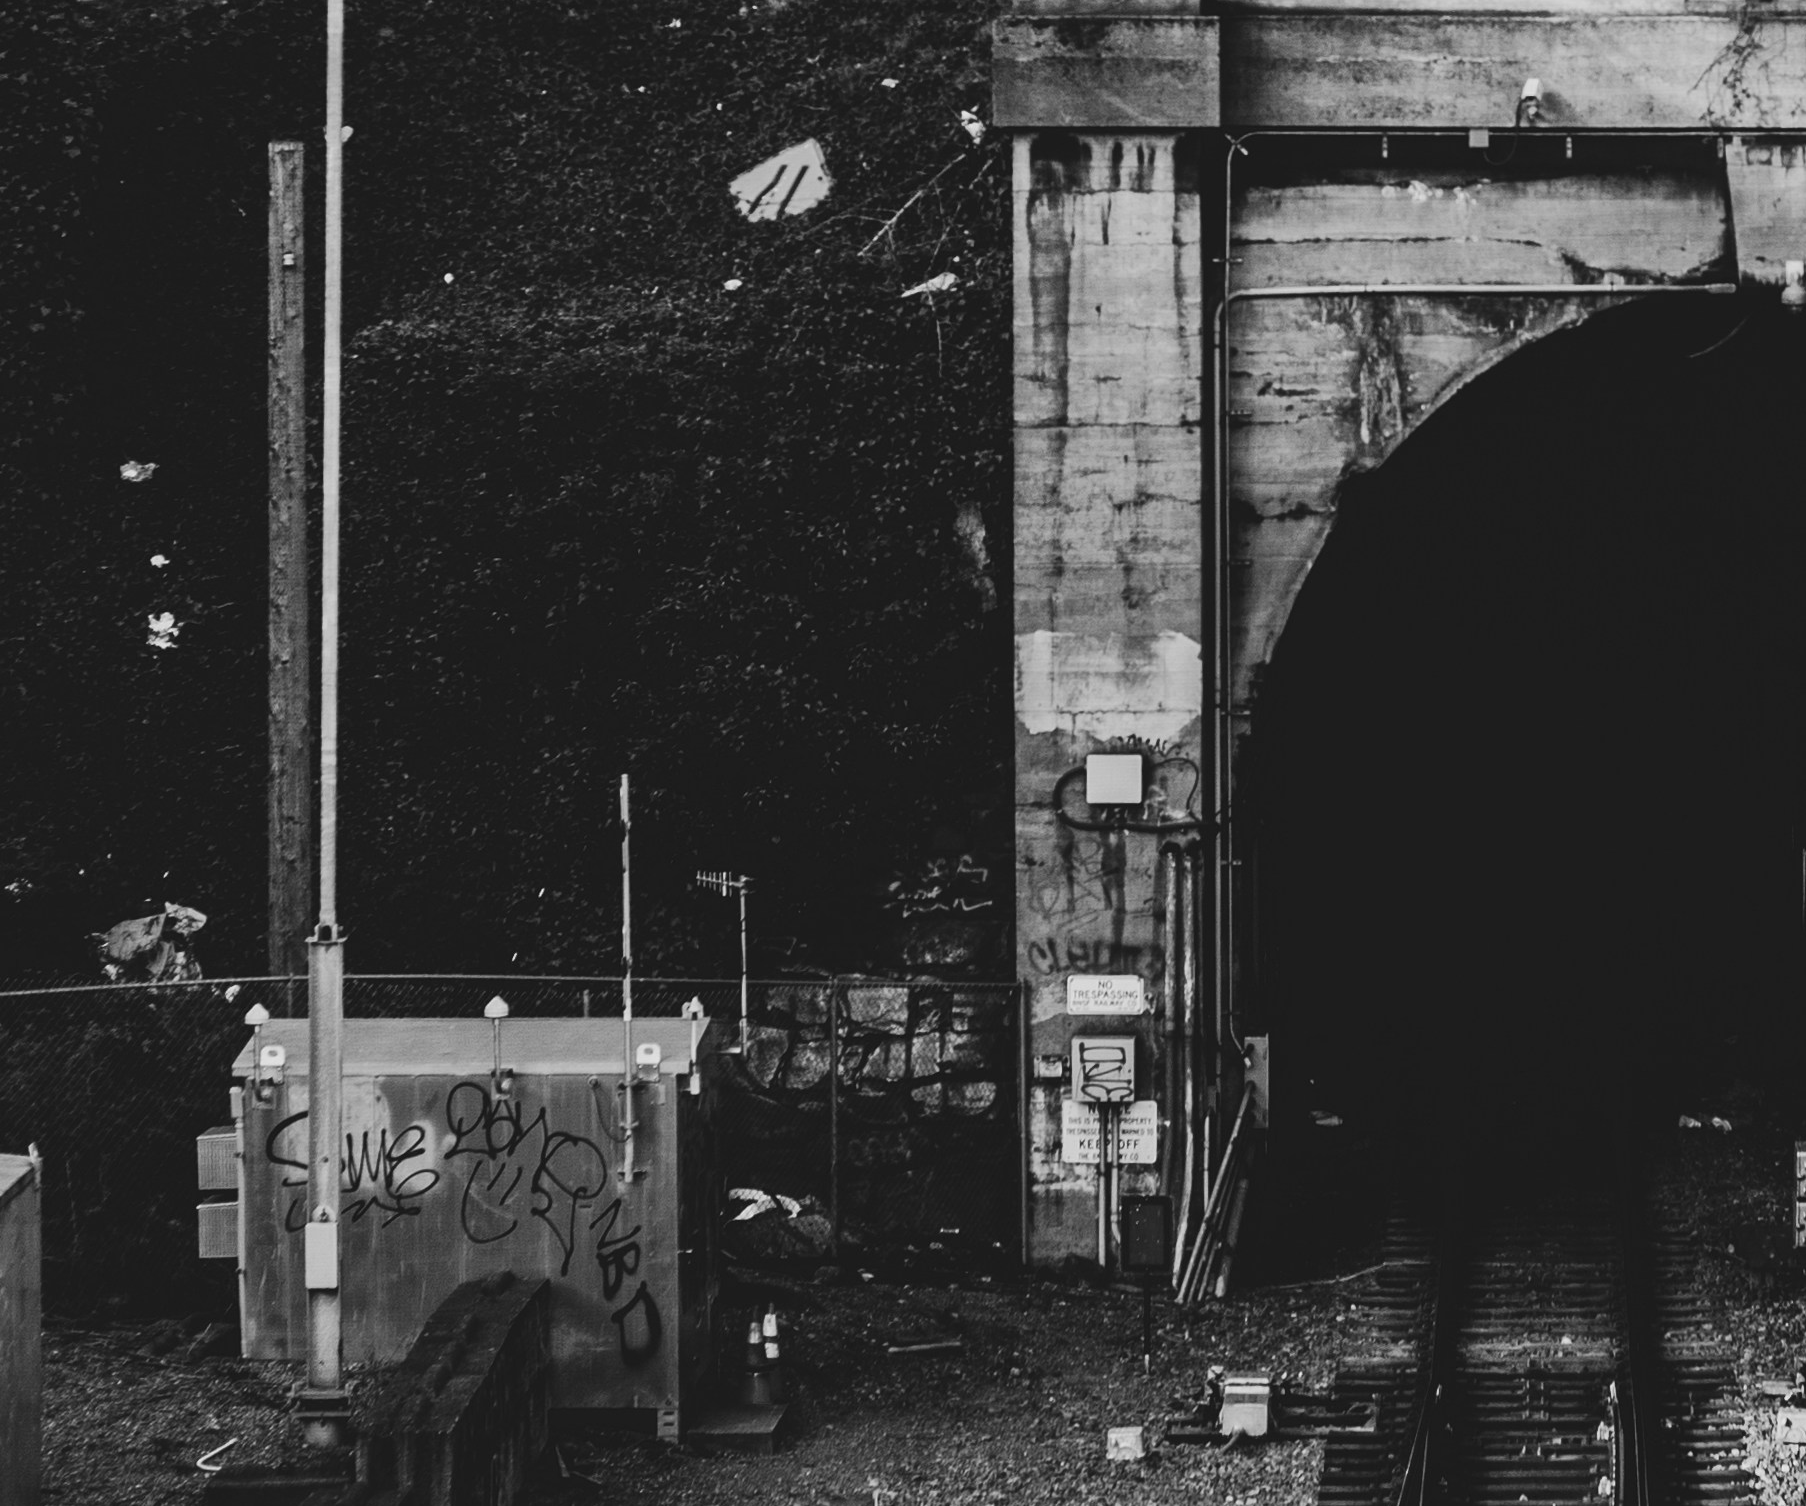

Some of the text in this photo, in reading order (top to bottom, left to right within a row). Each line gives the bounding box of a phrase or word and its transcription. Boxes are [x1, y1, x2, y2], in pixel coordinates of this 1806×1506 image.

[1098, 980, 1113, 990] NO
[1073, 990, 1138, 999] TRESPASSING
[1119, 1139, 1140, 1150] OFF
